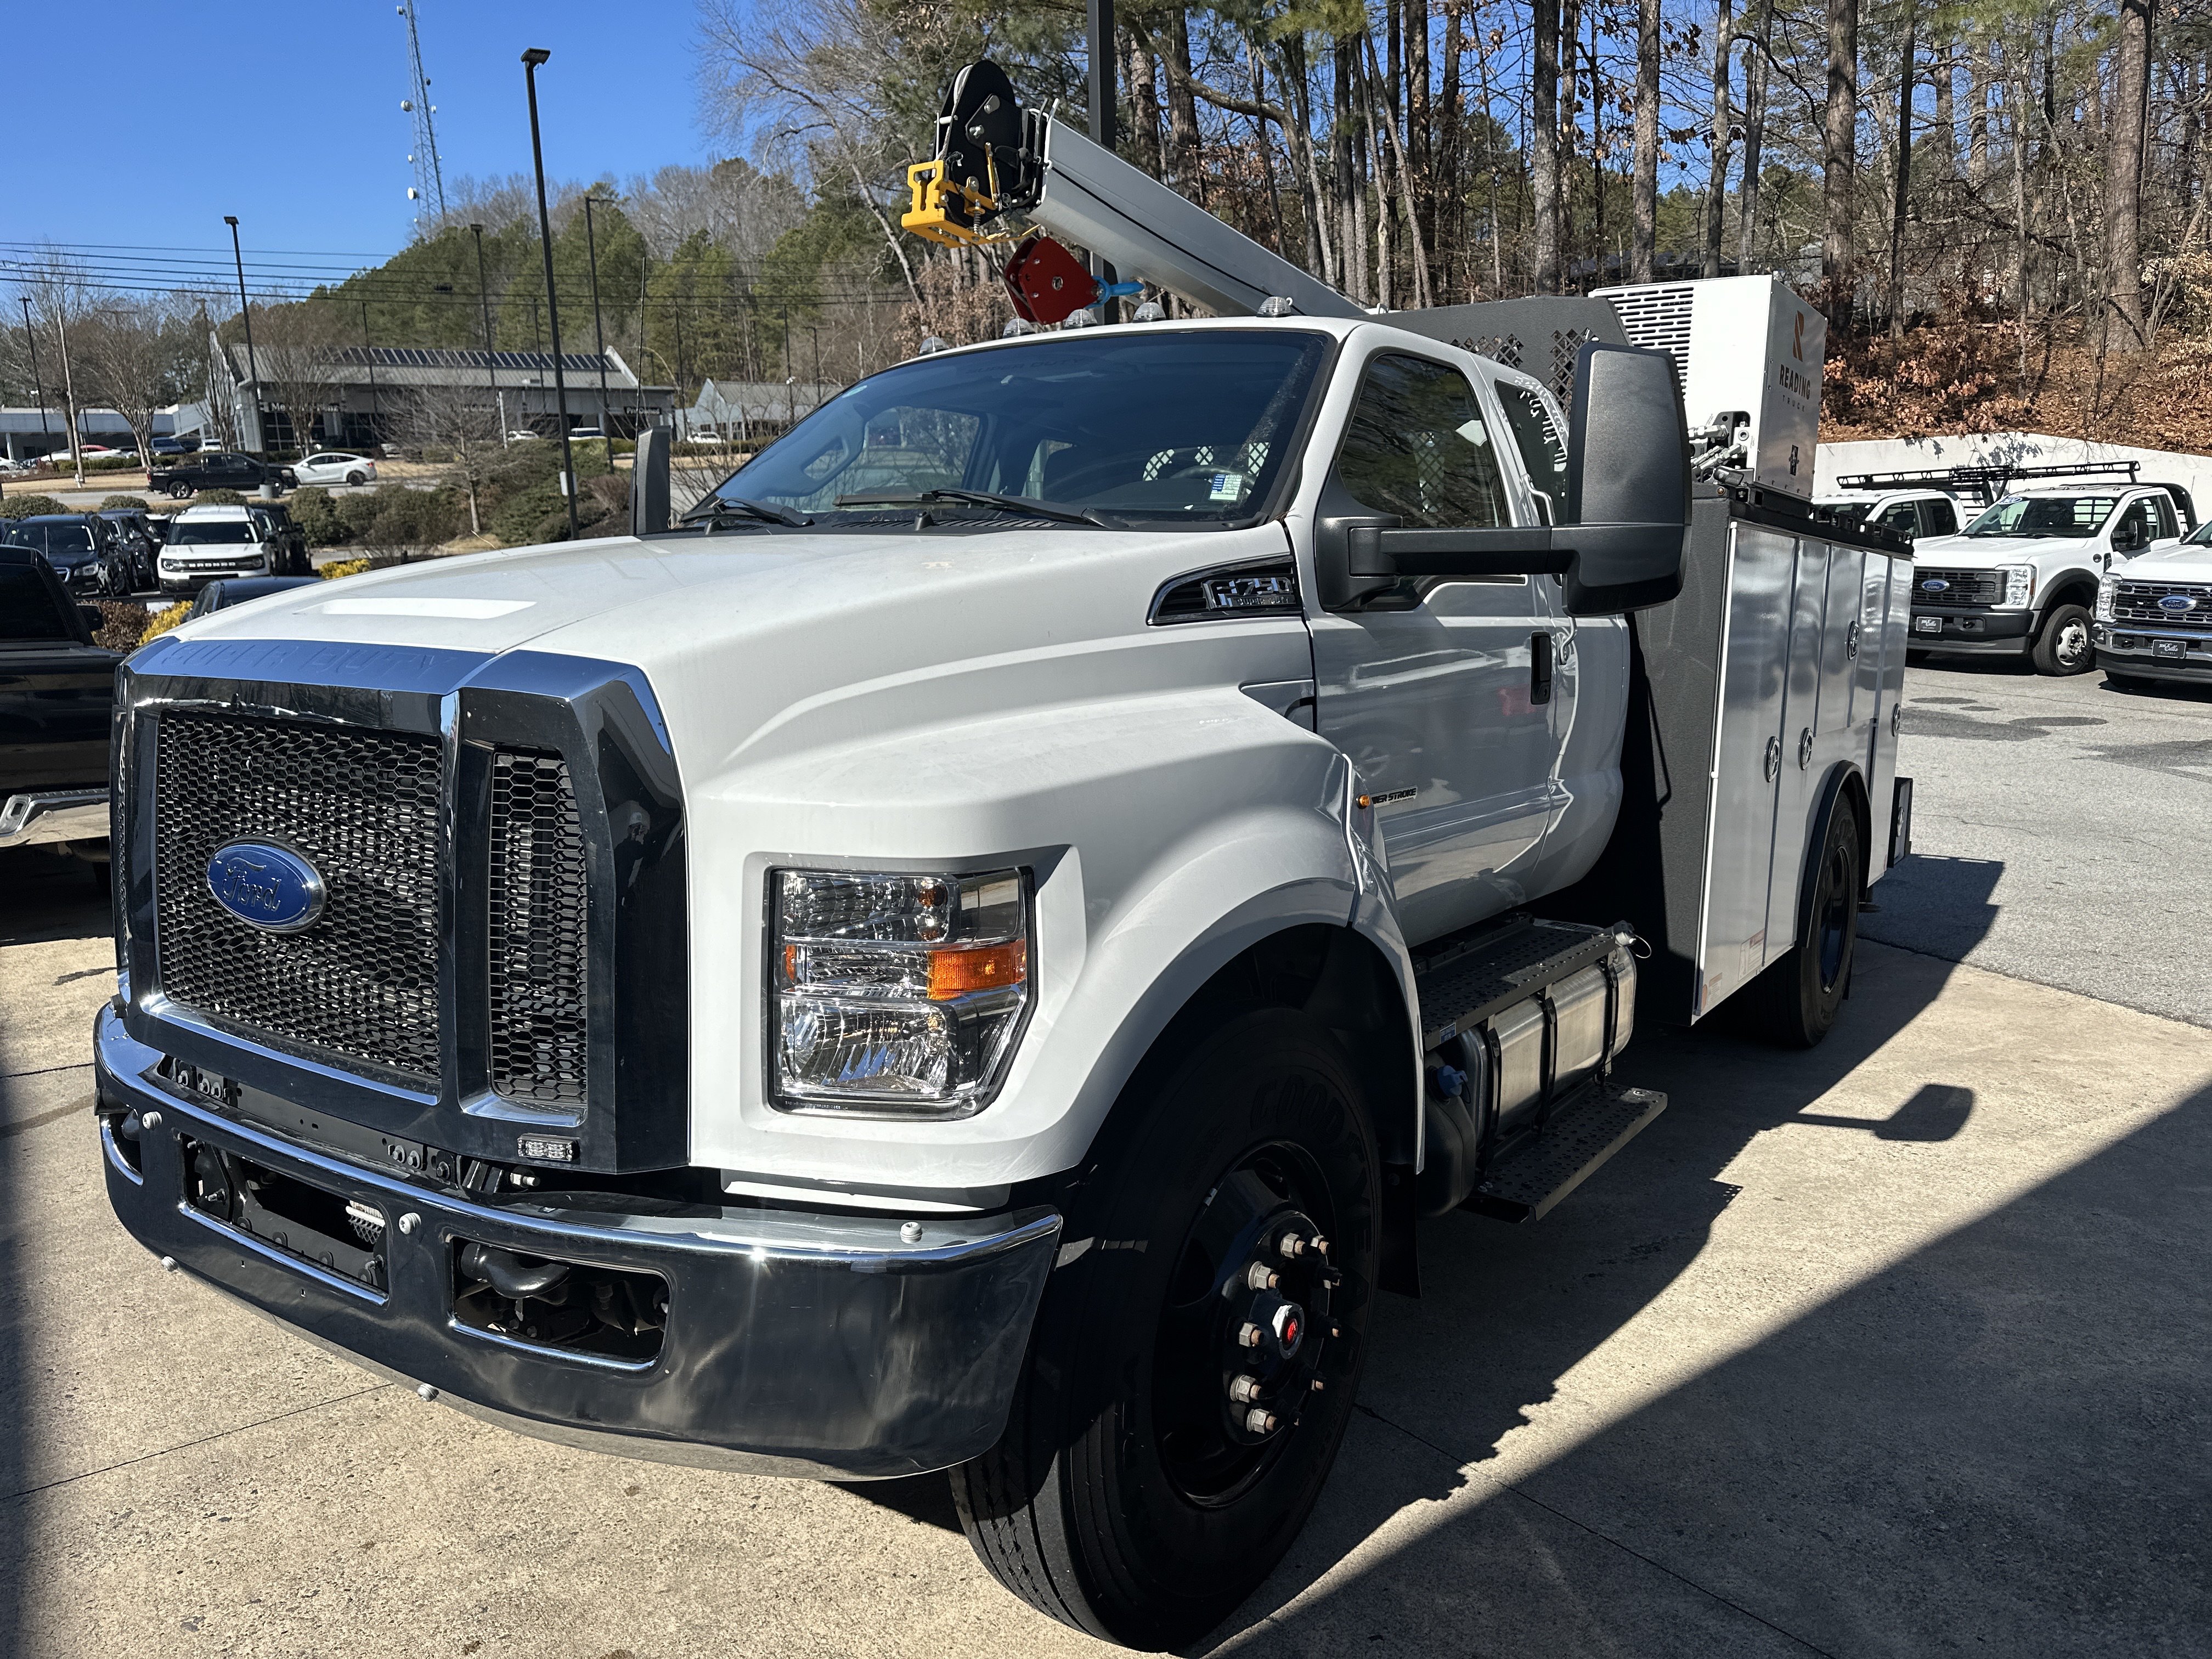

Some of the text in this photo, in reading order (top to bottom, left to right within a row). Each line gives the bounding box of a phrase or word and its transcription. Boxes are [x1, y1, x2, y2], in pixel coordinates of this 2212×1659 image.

[1779, 364, 1810, 400] READING
[1782, 394, 1805, 412] TRUCK
[2165, 600, 2184, 608] Ford
[160, 643, 460, 680] SUPER DUTY
[1388, 788, 1417, 801] STROKE
[221, 856, 281, 912] Ford
